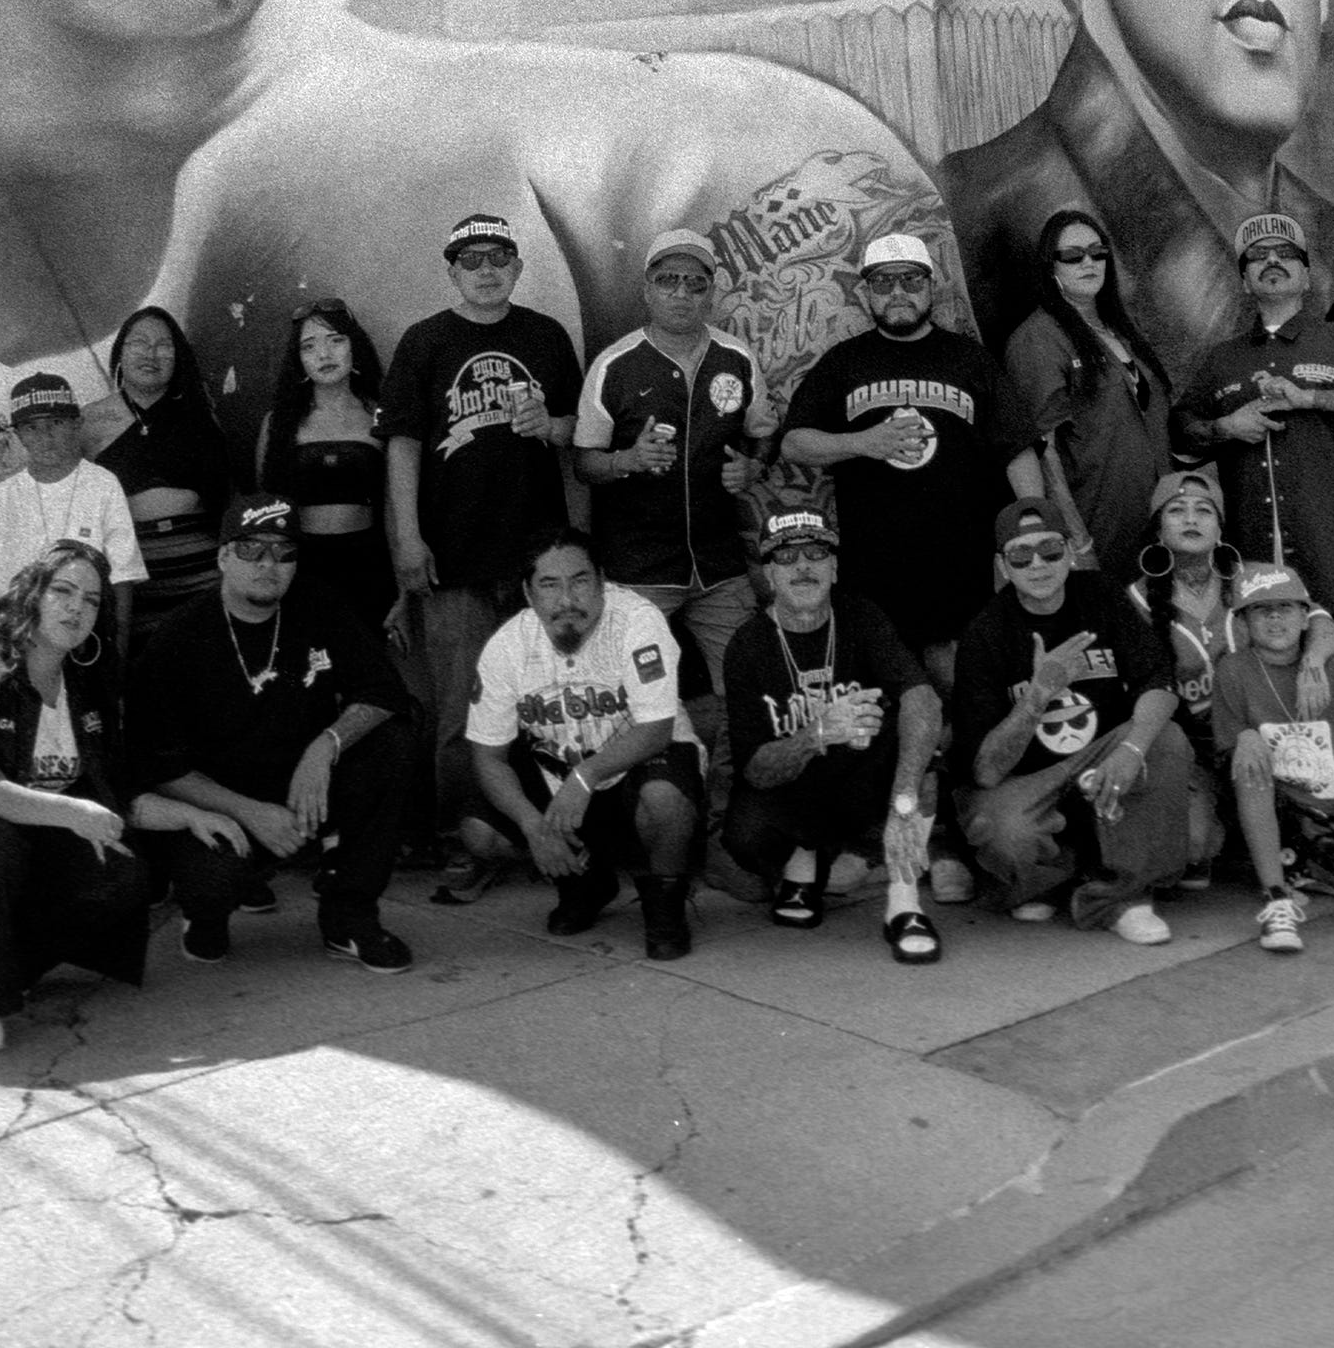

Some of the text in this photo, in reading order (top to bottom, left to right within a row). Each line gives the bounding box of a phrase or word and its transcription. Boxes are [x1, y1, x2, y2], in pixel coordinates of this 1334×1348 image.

[705, 203, 839, 288] Mane
[1242, 217, 1296, 244] OAKLAND
[846, 379, 974, 425] LOWRIDER
[768, 511, 824, 533] Compton
